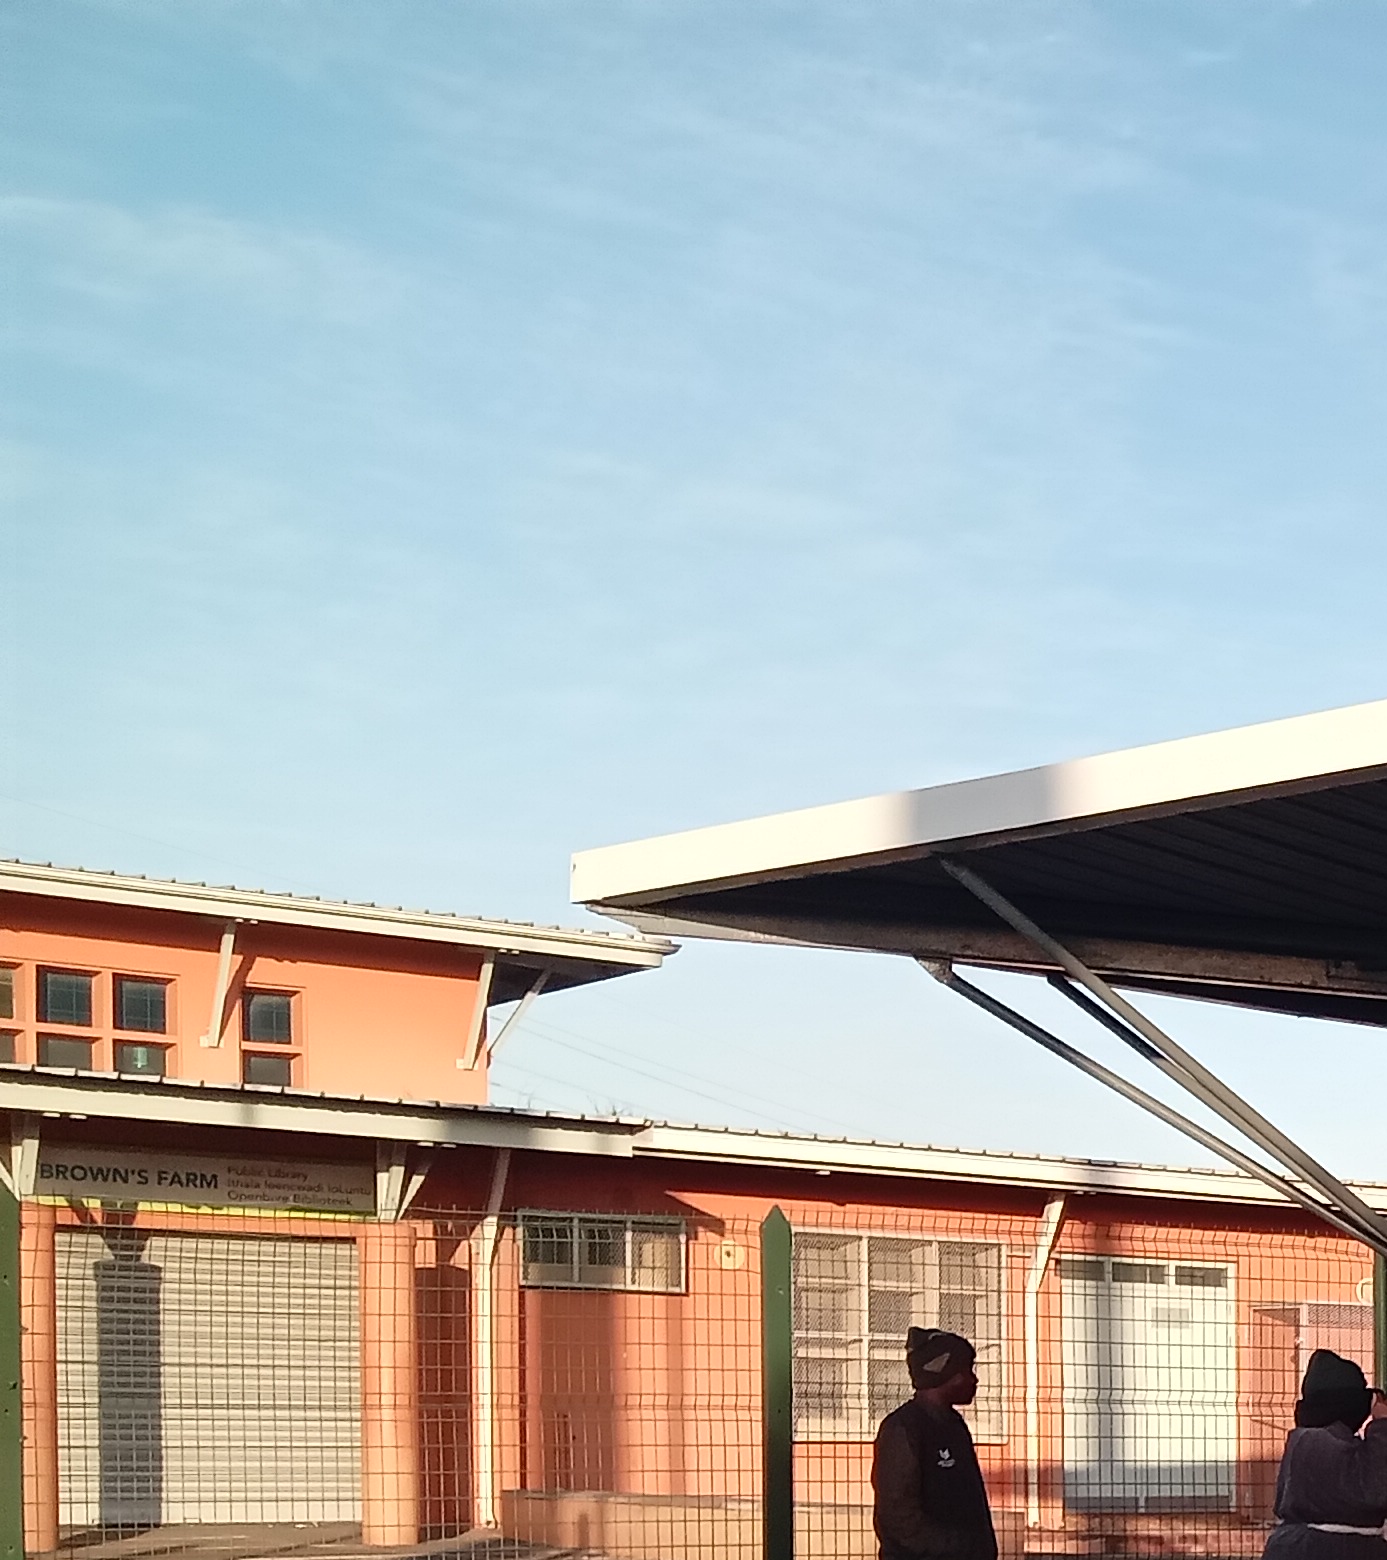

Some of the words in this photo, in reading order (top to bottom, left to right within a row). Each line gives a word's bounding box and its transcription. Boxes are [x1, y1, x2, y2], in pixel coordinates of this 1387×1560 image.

[39, 1163, 149, 1186] BROWN'S
[156, 1170, 219, 1189] FARM
[227, 1165, 263, 1178] Public
[268, 1168, 308, 1182] Library
